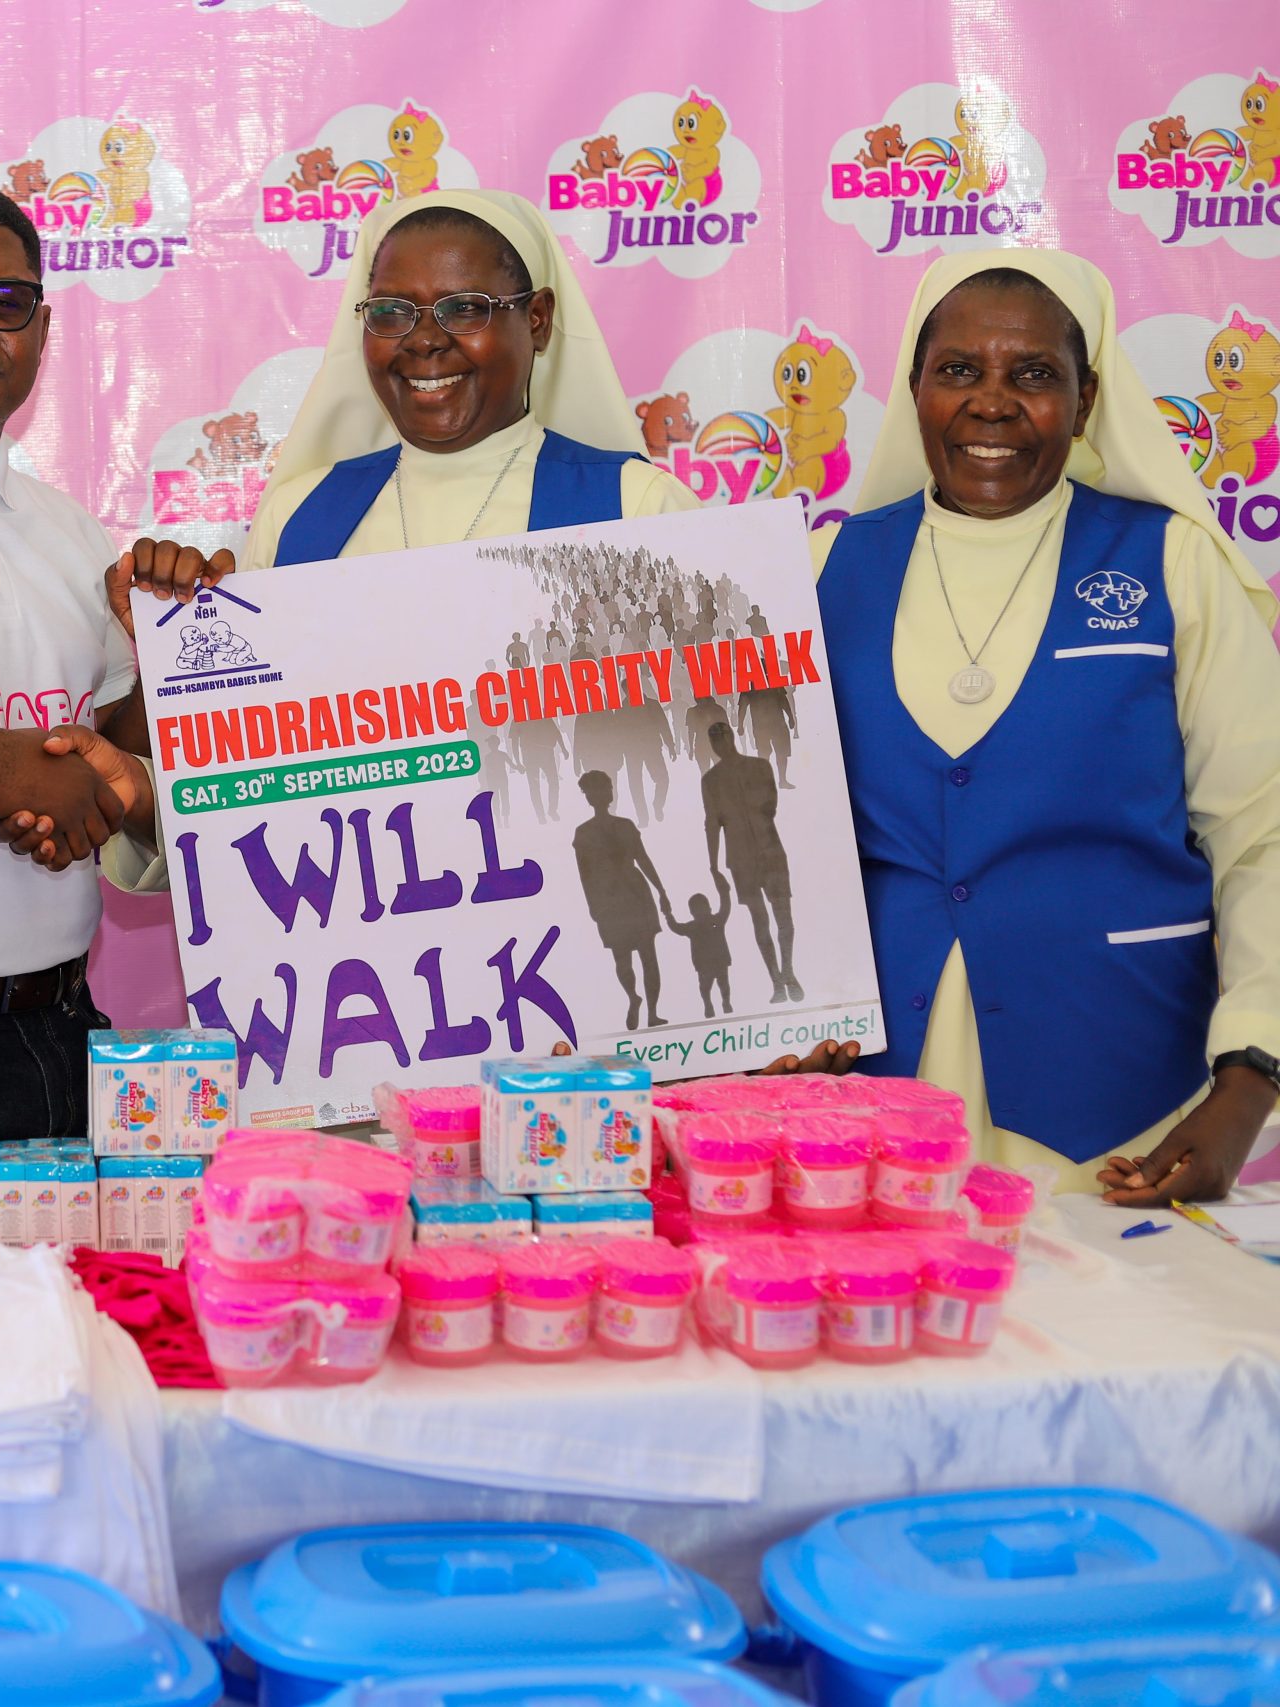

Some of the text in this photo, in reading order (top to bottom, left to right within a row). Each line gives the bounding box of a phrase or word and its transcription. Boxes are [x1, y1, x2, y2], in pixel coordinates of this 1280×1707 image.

[548, 171, 667, 211] Baby
[831, 161, 947, 201] Baby
[1118, 153, 1232, 192] Baby
[593, 202, 758, 264] Junior
[877, 192, 1042, 254] Junior
[194, 606, 218, 620] NBH
[1087, 616, 1139, 631] CWAS
[156, 629, 822, 772] FUNDRAISING CHARITY WALK
[157, 671, 284, 697] CWAS-NSAMBYA BABIES HOME
[181, 749, 475, 808] SAT, 30TH SEPTEMBER 2023
[175, 790, 546, 947] I WILL
[186, 924, 580, 1091] WALK
[616, 1009, 876, 1066] Every Child counts!
[116, 1093, 129, 1131] Junior
[128, 1081, 140, 1110] Baby
[201, 1079, 213, 1108] Baby
[340, 1102, 370, 1114] cbs
